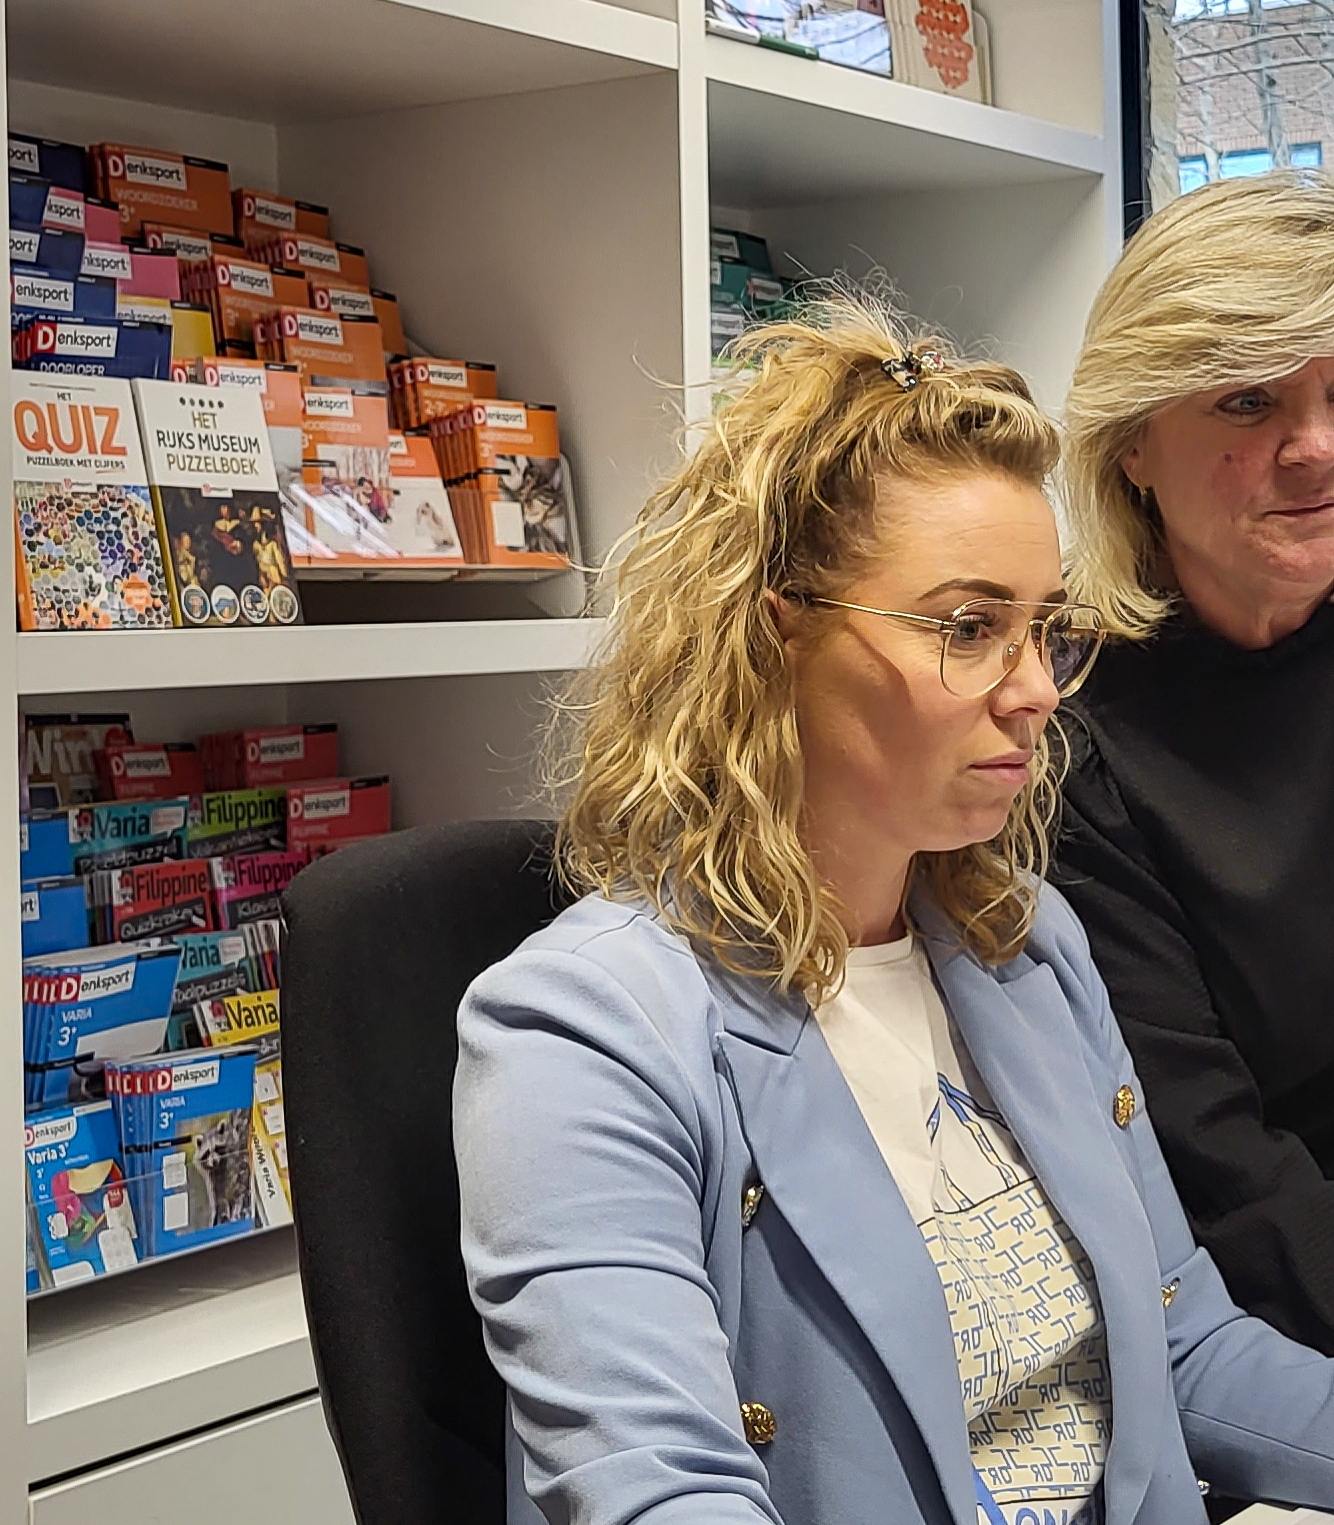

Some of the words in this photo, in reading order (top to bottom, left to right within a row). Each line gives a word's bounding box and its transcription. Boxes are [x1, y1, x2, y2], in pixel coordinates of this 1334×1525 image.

[108, 155, 183, 182] Denksport
[37, 326, 111, 350] Denksport
[40, 362, 105, 376] DOORLOPER
[14, 400, 128, 456] QUIZ
[192, 411, 217, 429] HET
[198, 433, 261, 454] MUSEUM
[27, 456, 75, 468] PUZZELBOEK
[167, 454, 259, 475] PUZZELBOEK
[206, 791, 286, 829] Filippine
[95, 807, 149, 839] Varia
[135, 868, 207, 903] Filippine
[61, 1007, 92, 1022] VARIA
[227, 995, 279, 1031] Varia
[28, 1147, 57, 1165] Varia
